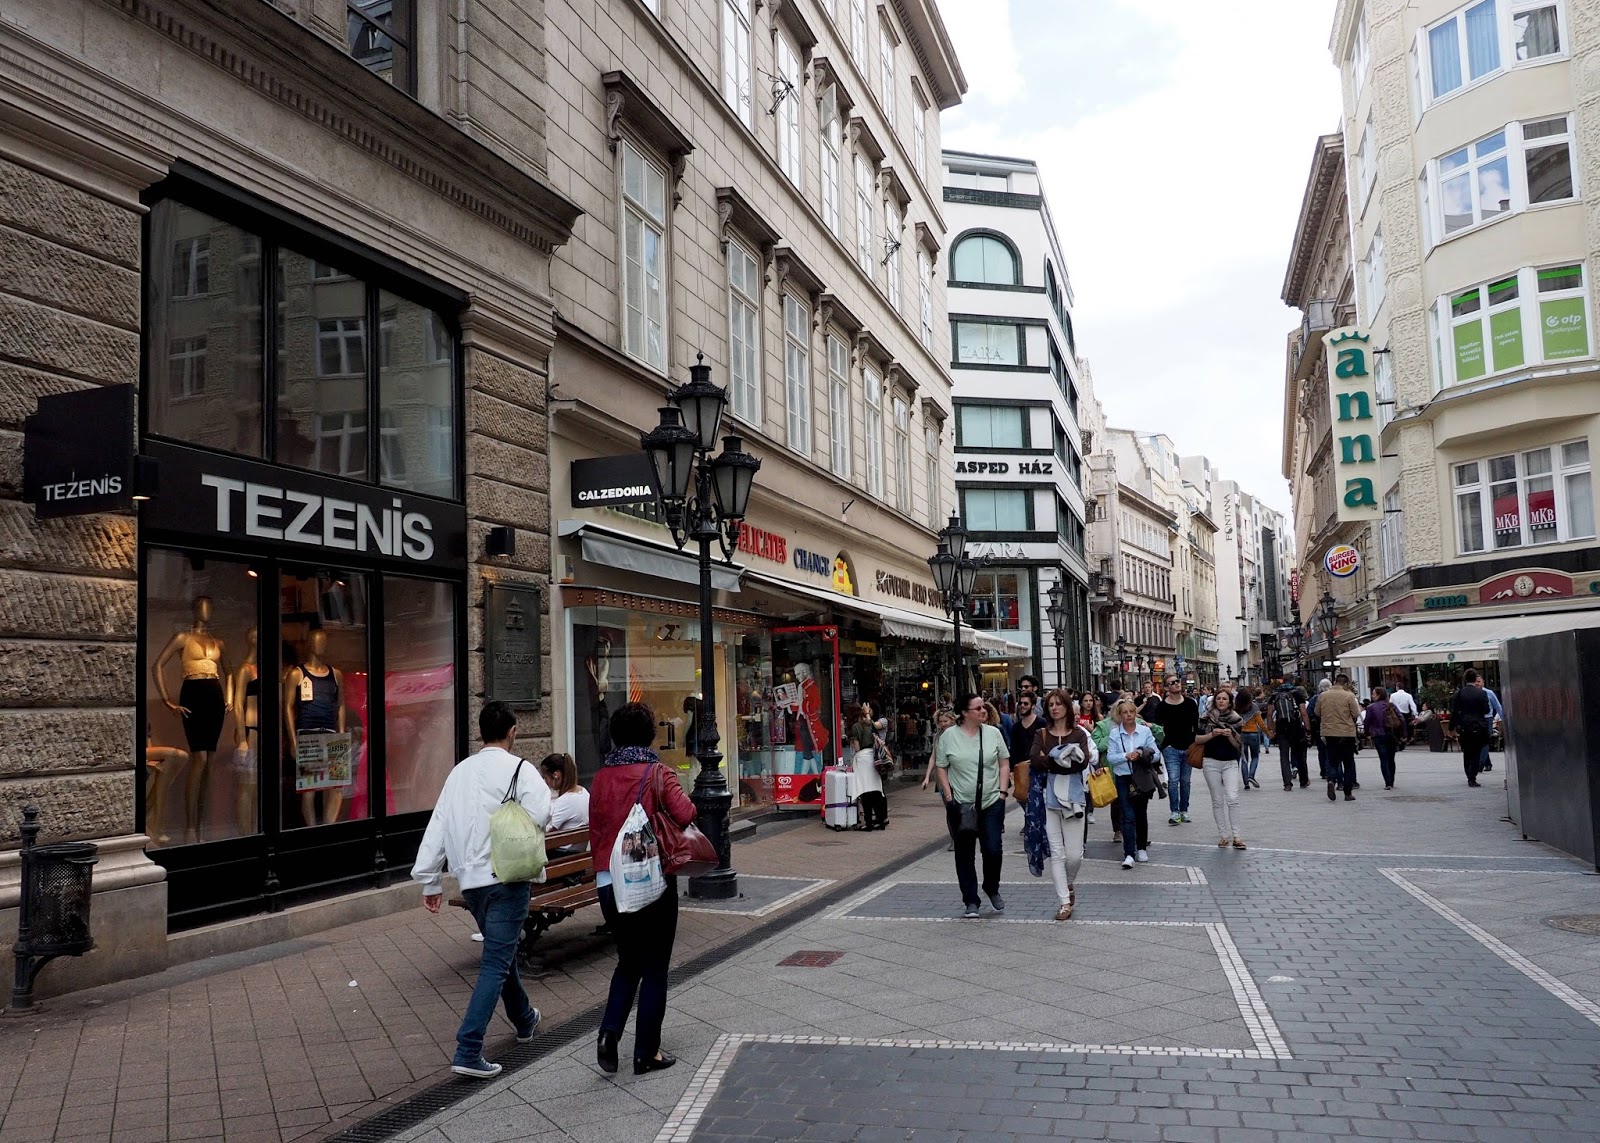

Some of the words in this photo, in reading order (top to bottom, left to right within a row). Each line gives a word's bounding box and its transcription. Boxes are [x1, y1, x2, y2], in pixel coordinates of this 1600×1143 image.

[1561, 314, 1581, 325] otp
[960, 344, 1005, 361] ZARA
[1335, 347, 1378, 508] anna
[954, 461, 1009, 475] ASPED
[1018, 458, 1053, 475] HÁZ
[578, 485, 652, 501] CALZEDONIA
[1223, 493, 1233, 541] FONTANA
[1496, 513, 1518, 528] MKB
[1531, 507, 1554, 523] MKB
[973, 543, 1030, 559] ZARA
[1328, 549, 1355, 564] BURGER
[793, 547, 830, 577] CHANGE
[1330, 555, 1357, 571] KING
[875, 569, 911, 600] SOUVENIR
[911, 581, 928, 606] AERO
[927, 587, 945, 610] SOUV
[1424, 594, 1468, 609] anna
